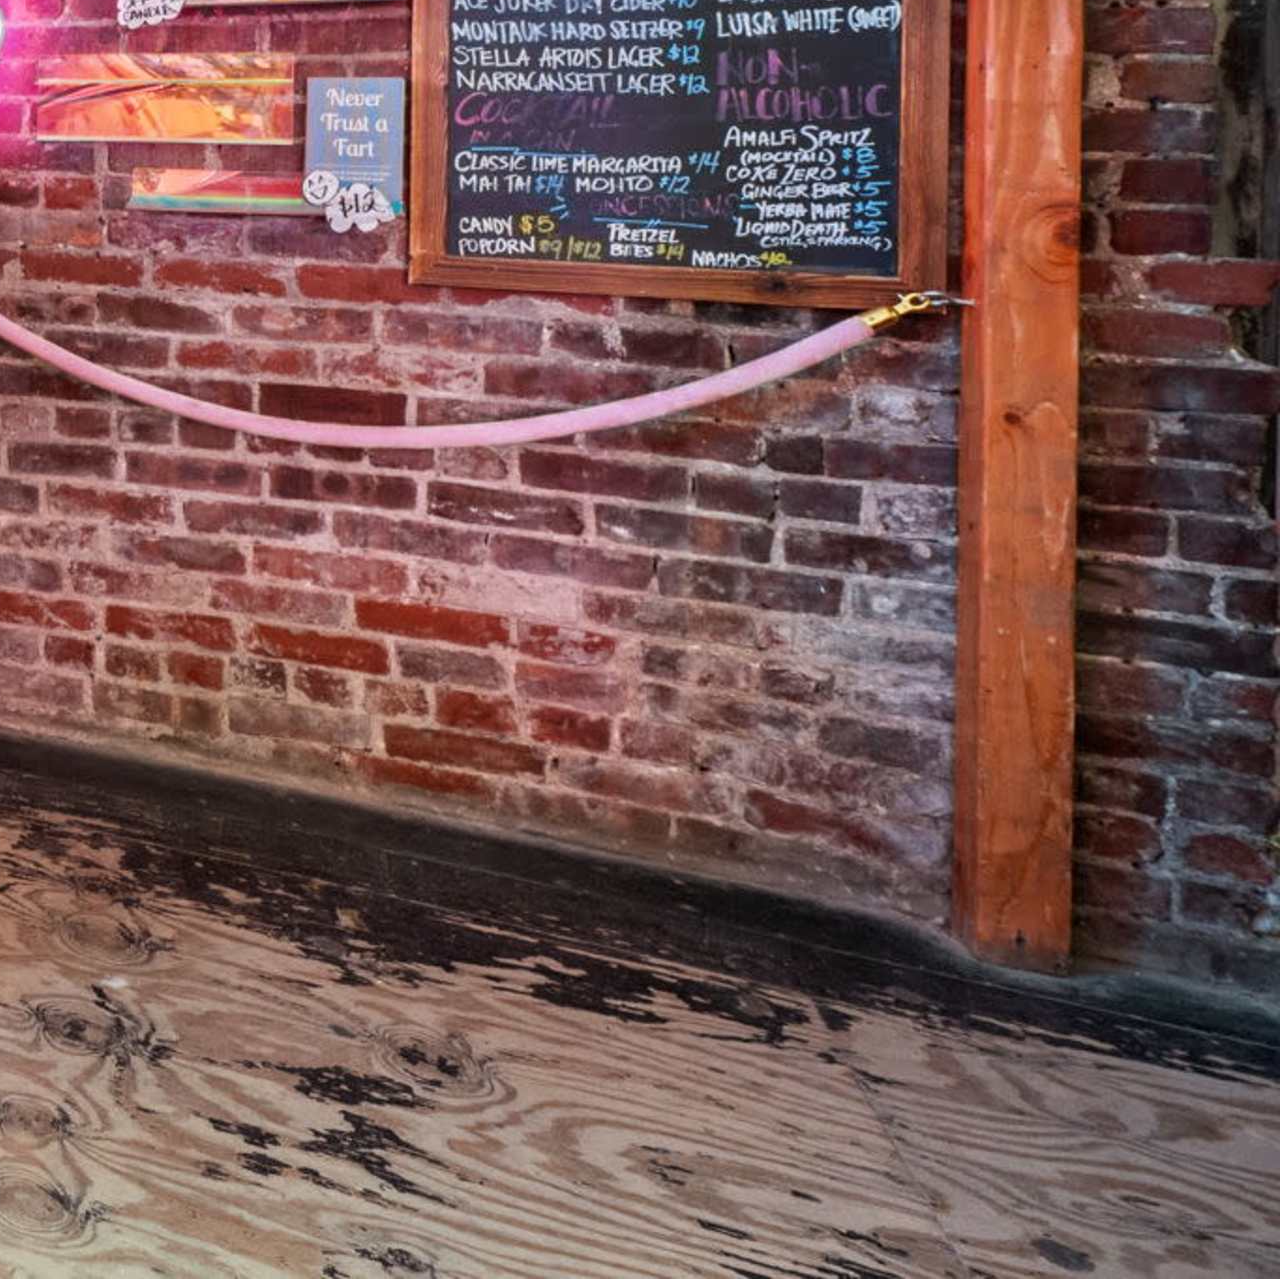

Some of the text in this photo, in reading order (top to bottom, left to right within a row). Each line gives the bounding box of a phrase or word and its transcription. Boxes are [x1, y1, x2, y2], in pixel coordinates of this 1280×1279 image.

[452, 20, 548, 44] MONTAUK
[551, 21, 606, 42] HARD
[610, 18, 684, 40] SELTZER
[716, 11, 778, 38] LUISA
[782, 7, 844, 33] WHITE
[453, 44, 701, 70] STELLA ARTOIS LAGER $12
[456, 69, 710, 95] NARRAGANSETT LAGER $12
[326, 87, 385, 107] Never
[717, 84, 893, 122] ALCOHOLIC
[320, 111, 370, 132] Trust
[800, 125, 874, 152] SPRITZ
[455, 151, 528, 173] CLASSIC
[531, 155, 569, 173] LIME
[572, 155, 682, 174] MARGARITA
[458, 174, 690, 195] MAI TAI $14 MOJITO $12
[726, 164, 836, 185] COKE ZERO
[741, 183, 811, 200] GINGER
[458, 215, 556, 237] CANDY $5
[607, 222, 680, 243] PRETZEL
[458, 236, 535, 257] POPCORN
[610, 242, 654, 257] BITES
[692, 249, 762, 268] NACHOS
